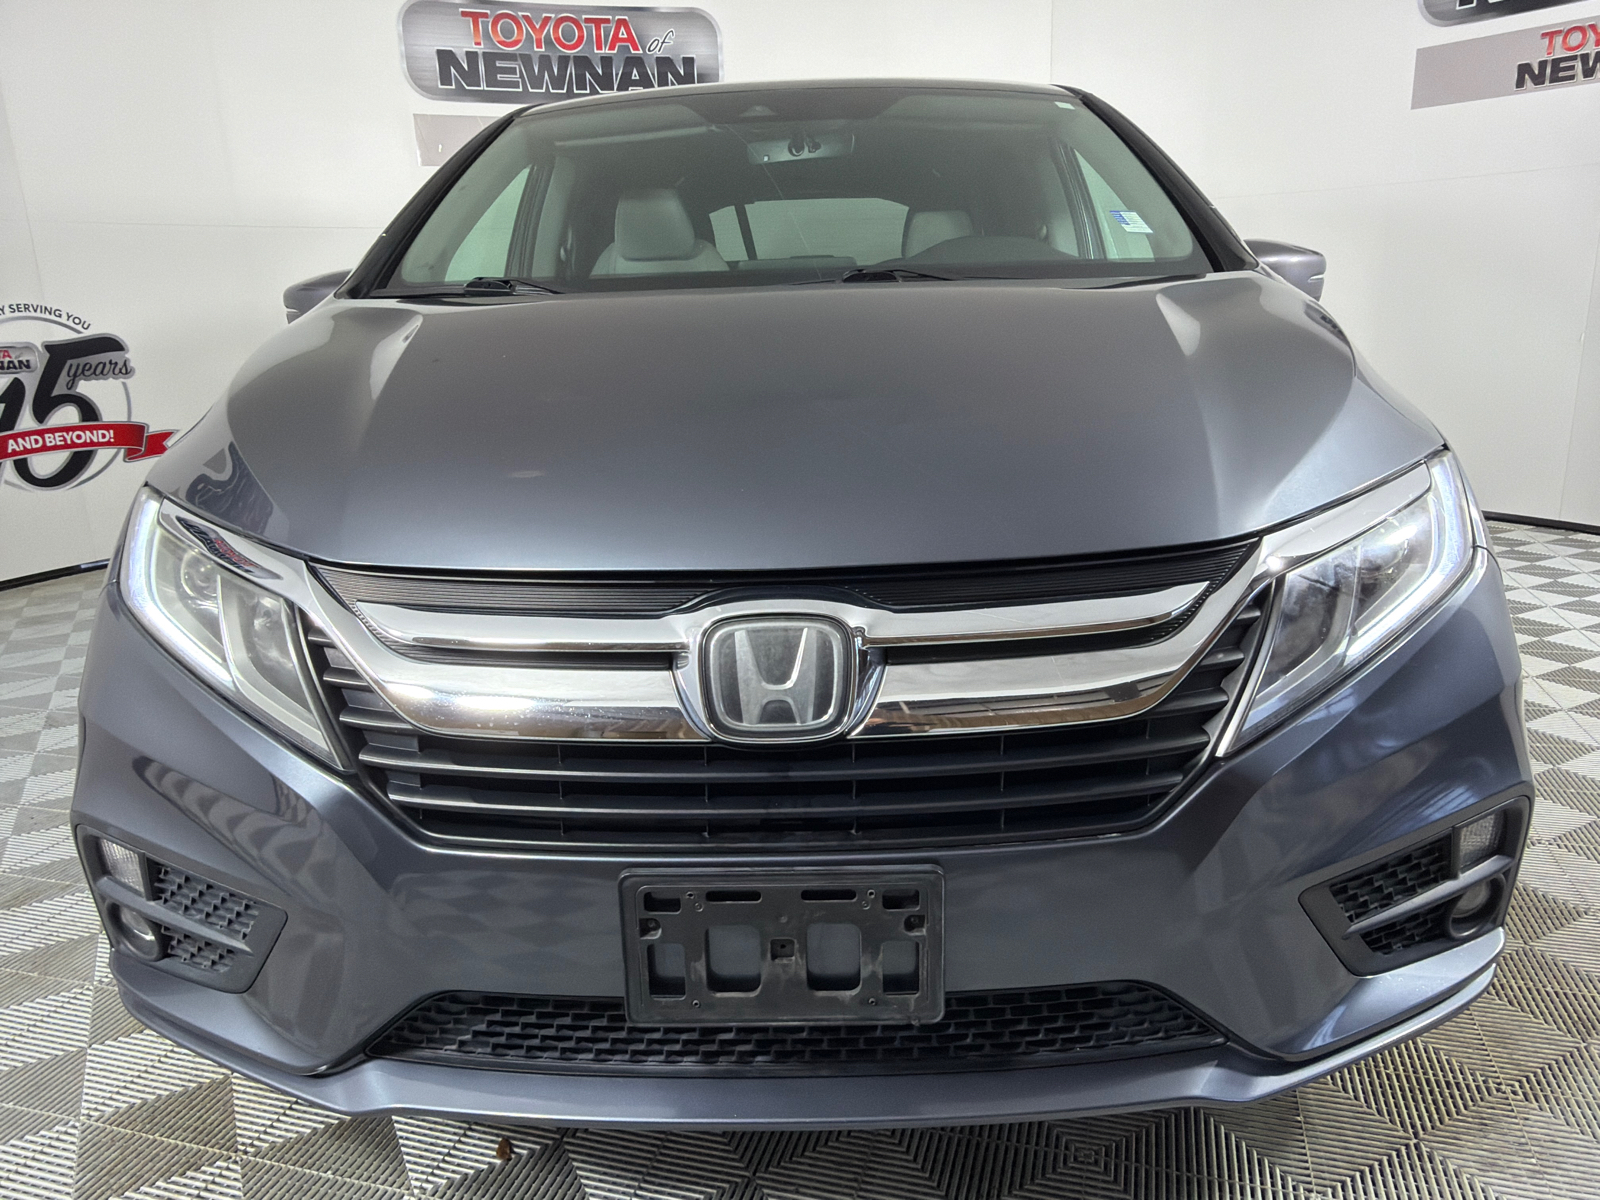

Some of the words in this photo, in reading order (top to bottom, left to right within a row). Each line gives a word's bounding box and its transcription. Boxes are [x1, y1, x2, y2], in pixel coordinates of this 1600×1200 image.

[459, 9, 643, 54] TOYOTA
[646, 30, 675, 54] of
[435, 49, 697, 93] NEWNAN
[8, 303, 63, 319] SERVING
[66, 312, 91, 331] YOU
[66, 357, 133, 391] years
[7, 435, 43, 453] AND
[44, 429, 115, 447] BEYOND!
